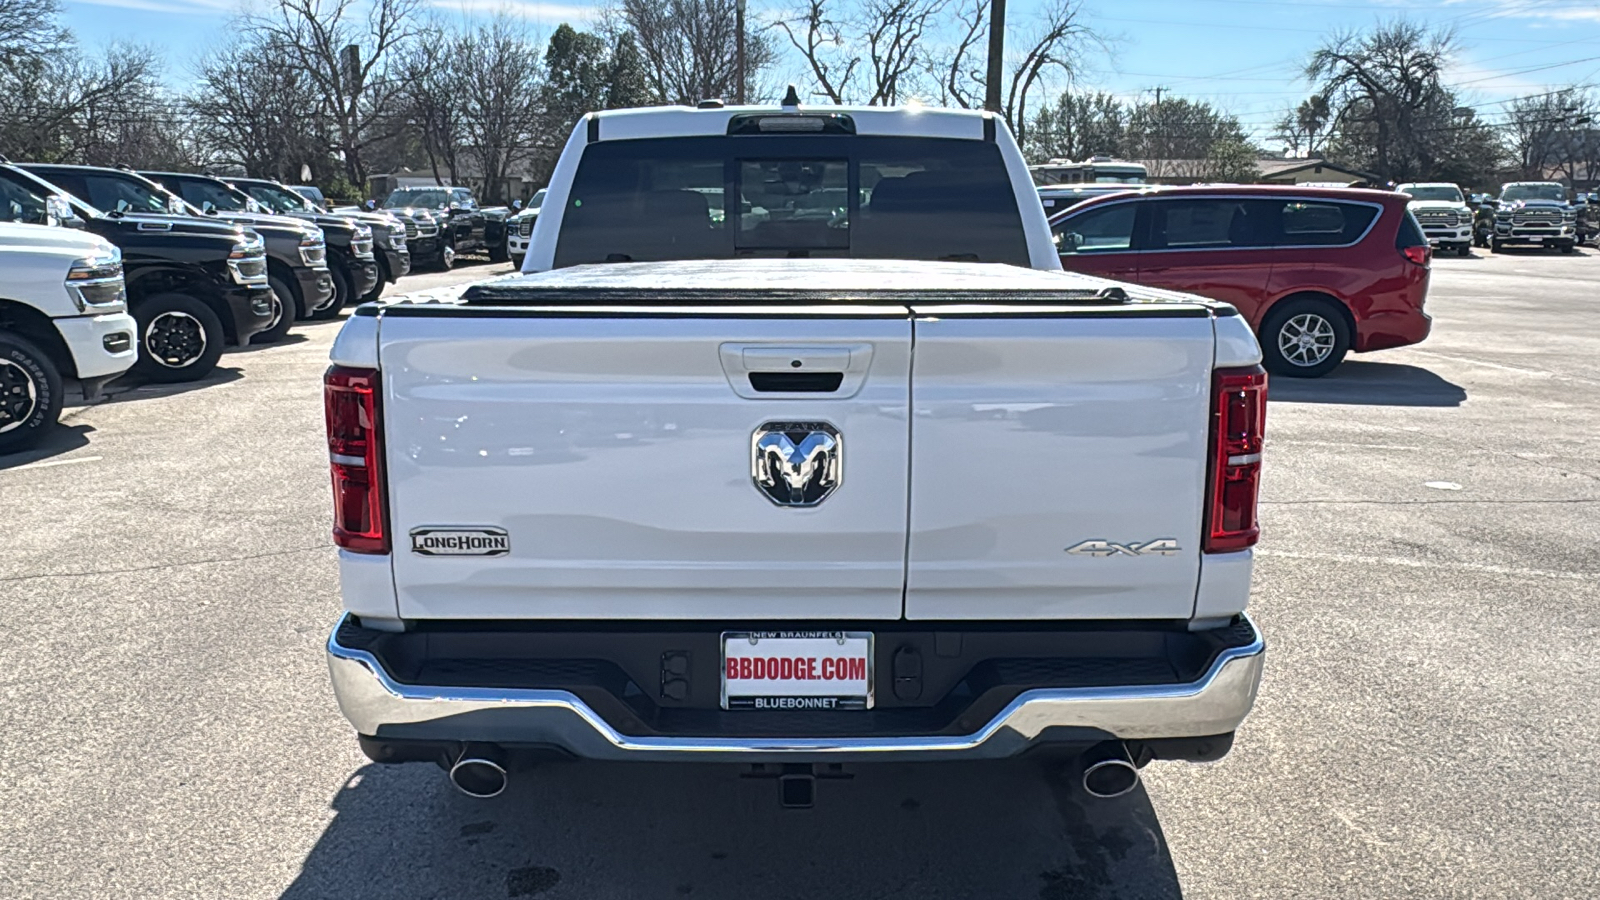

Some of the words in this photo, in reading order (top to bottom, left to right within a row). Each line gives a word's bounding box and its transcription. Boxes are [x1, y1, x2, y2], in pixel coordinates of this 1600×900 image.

[753, 631, 777, 639] NEW
[780, 631, 842, 639] BRAUNFELS
[726, 657, 866, 681] BBDODGE.COM
[755, 698, 838, 709] BLUEBONNET
